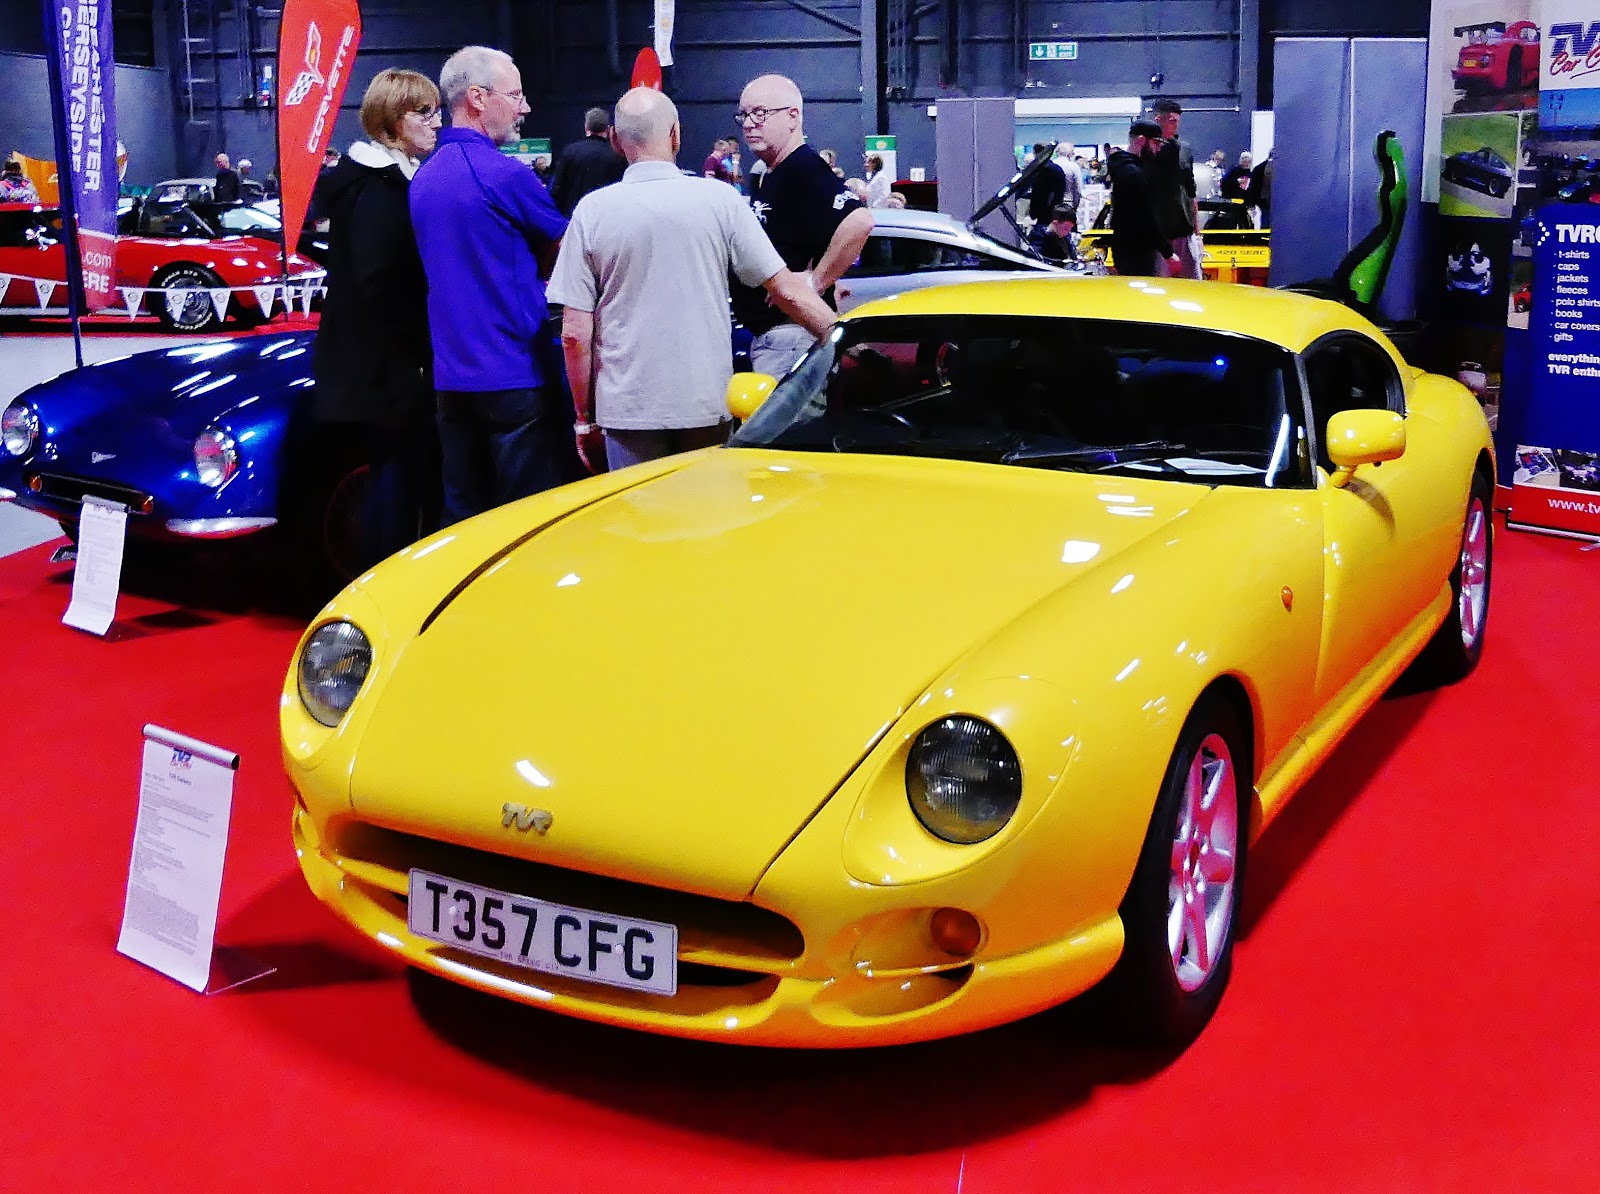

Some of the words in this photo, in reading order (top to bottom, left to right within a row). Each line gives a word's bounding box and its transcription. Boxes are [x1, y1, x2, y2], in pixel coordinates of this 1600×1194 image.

[1550, 51, 1582, 76] Car
[69, 0, 91, 173] ERSEYSIDE
[307, 25, 355, 154] CORVETTE
[1558, 250, 1590, 259] t-shirts
[1557, 263, 1580, 271] caps
[1556, 273, 1589, 284] jackets
[1556, 284, 1588, 295] fleeces
[1555, 297, 1576, 307] polo
[1577, 298, 1600, 307] shirts
[1555, 308, 1583, 318] books
[1570, 322, 1600, 331] covers
[1553, 331, 1574, 342] gifts
[1547, 364, 1570, 375] TVR
[501, 802, 554, 836] TVR
[425, 880, 538, 957] T357
[553, 914, 655, 981] CFG
